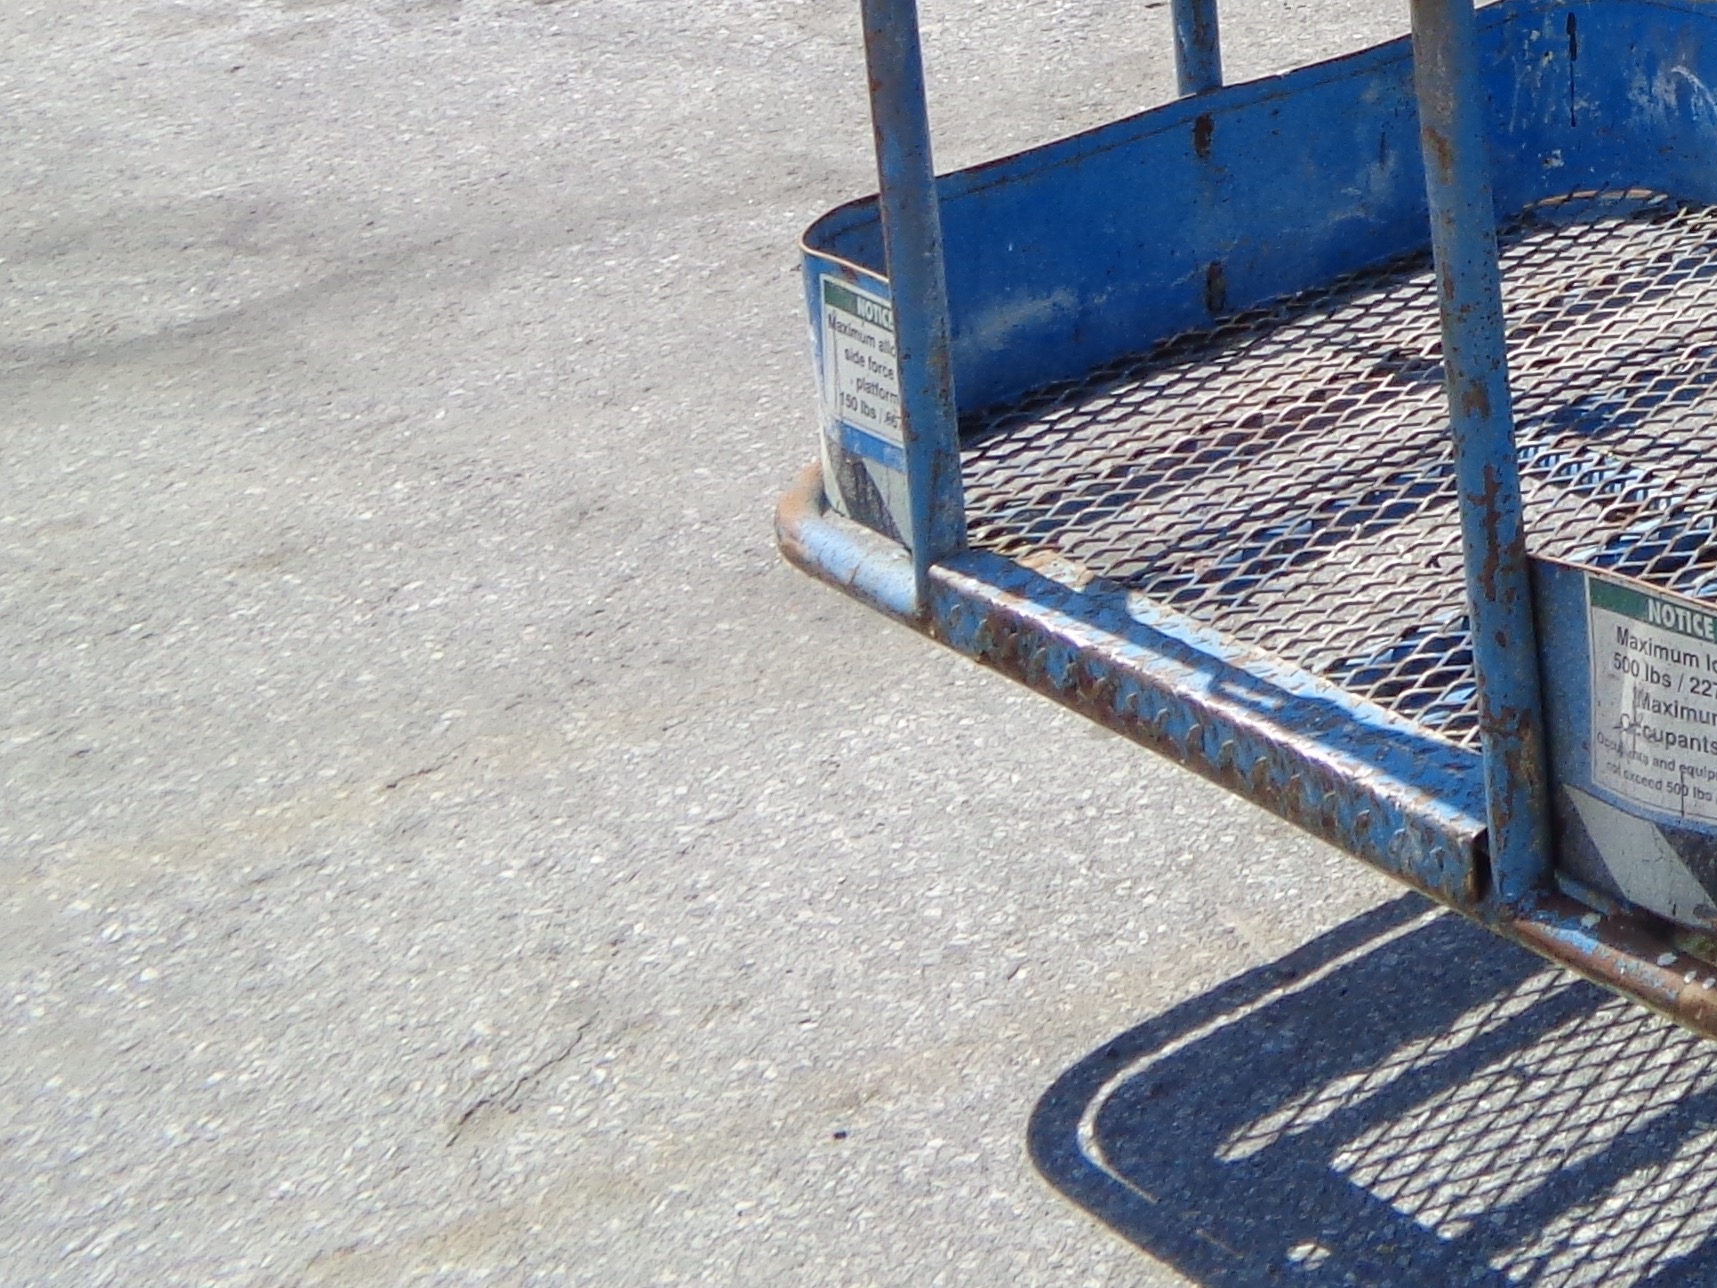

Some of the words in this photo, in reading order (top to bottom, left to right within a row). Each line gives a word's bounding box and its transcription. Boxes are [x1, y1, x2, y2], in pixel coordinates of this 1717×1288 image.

[828, 313, 876, 347] Maximum
[845, 348, 865, 368] side
[868, 356, 894, 380] force
[839, 392, 858, 412] 150
[861, 400, 876, 420] lbs
[1647, 598, 1714, 641] NOTICE
[1616, 626, 1700, 669] Maximum
[1612, 652, 1640, 678] 500
[1644, 664, 1672, 688] lbs
[1652, 758, 1675, 772] and
[1623, 769, 1662, 791] exceed
[1666, 782, 1689, 797] 500
[1693, 787, 1712, 802] lbs
